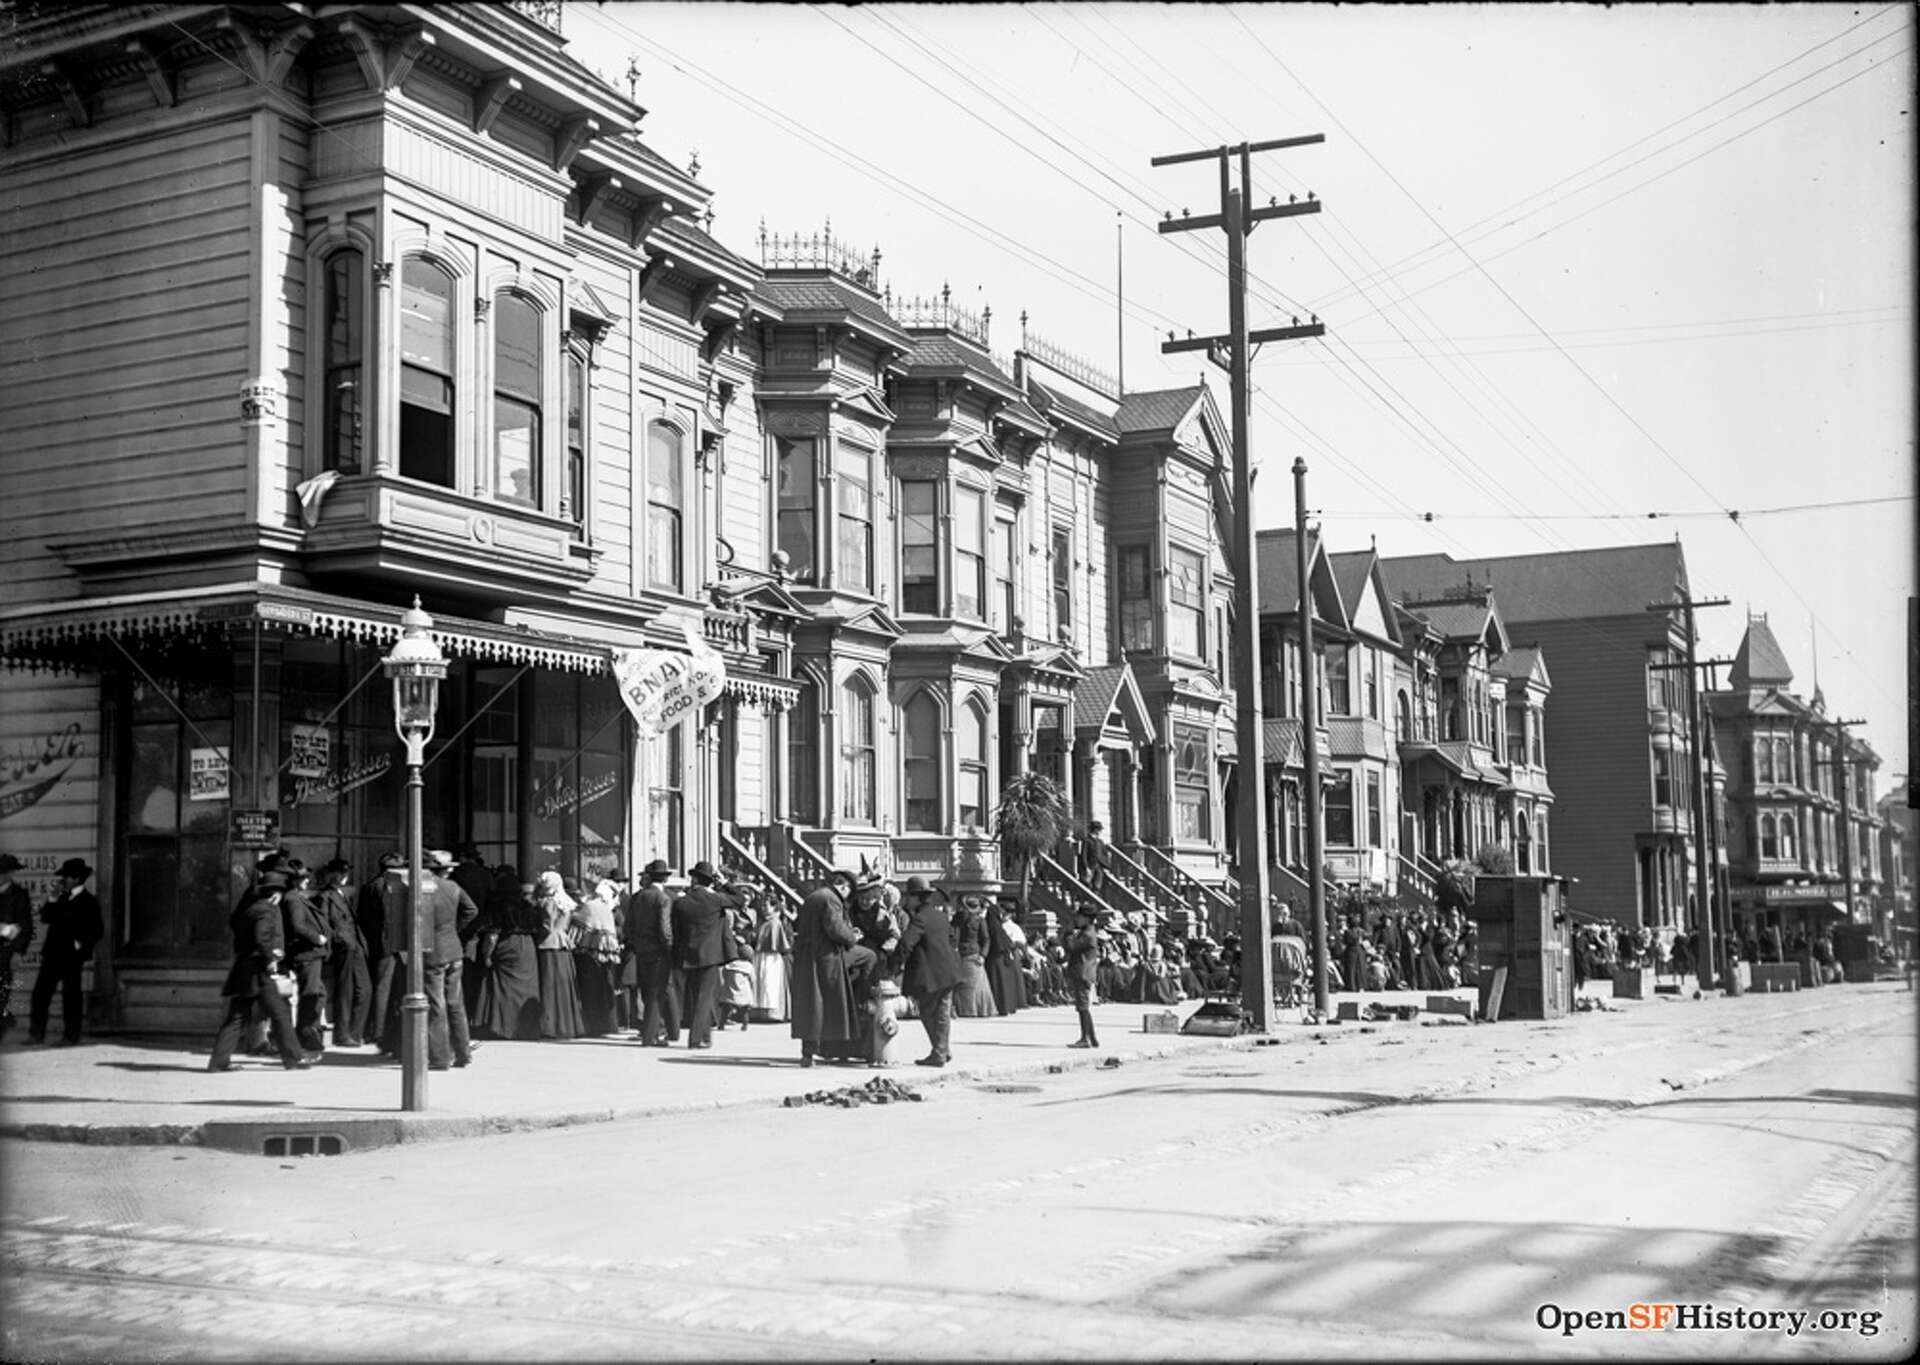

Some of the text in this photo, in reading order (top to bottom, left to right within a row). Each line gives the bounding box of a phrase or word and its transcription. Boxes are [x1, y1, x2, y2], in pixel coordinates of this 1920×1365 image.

[254, 386, 275, 396] LET
[659, 694, 692, 722] FOOD
[309, 737, 327, 748] LET
[208, 758, 226, 769] LET
[16, 856, 57, 871] SALADS
